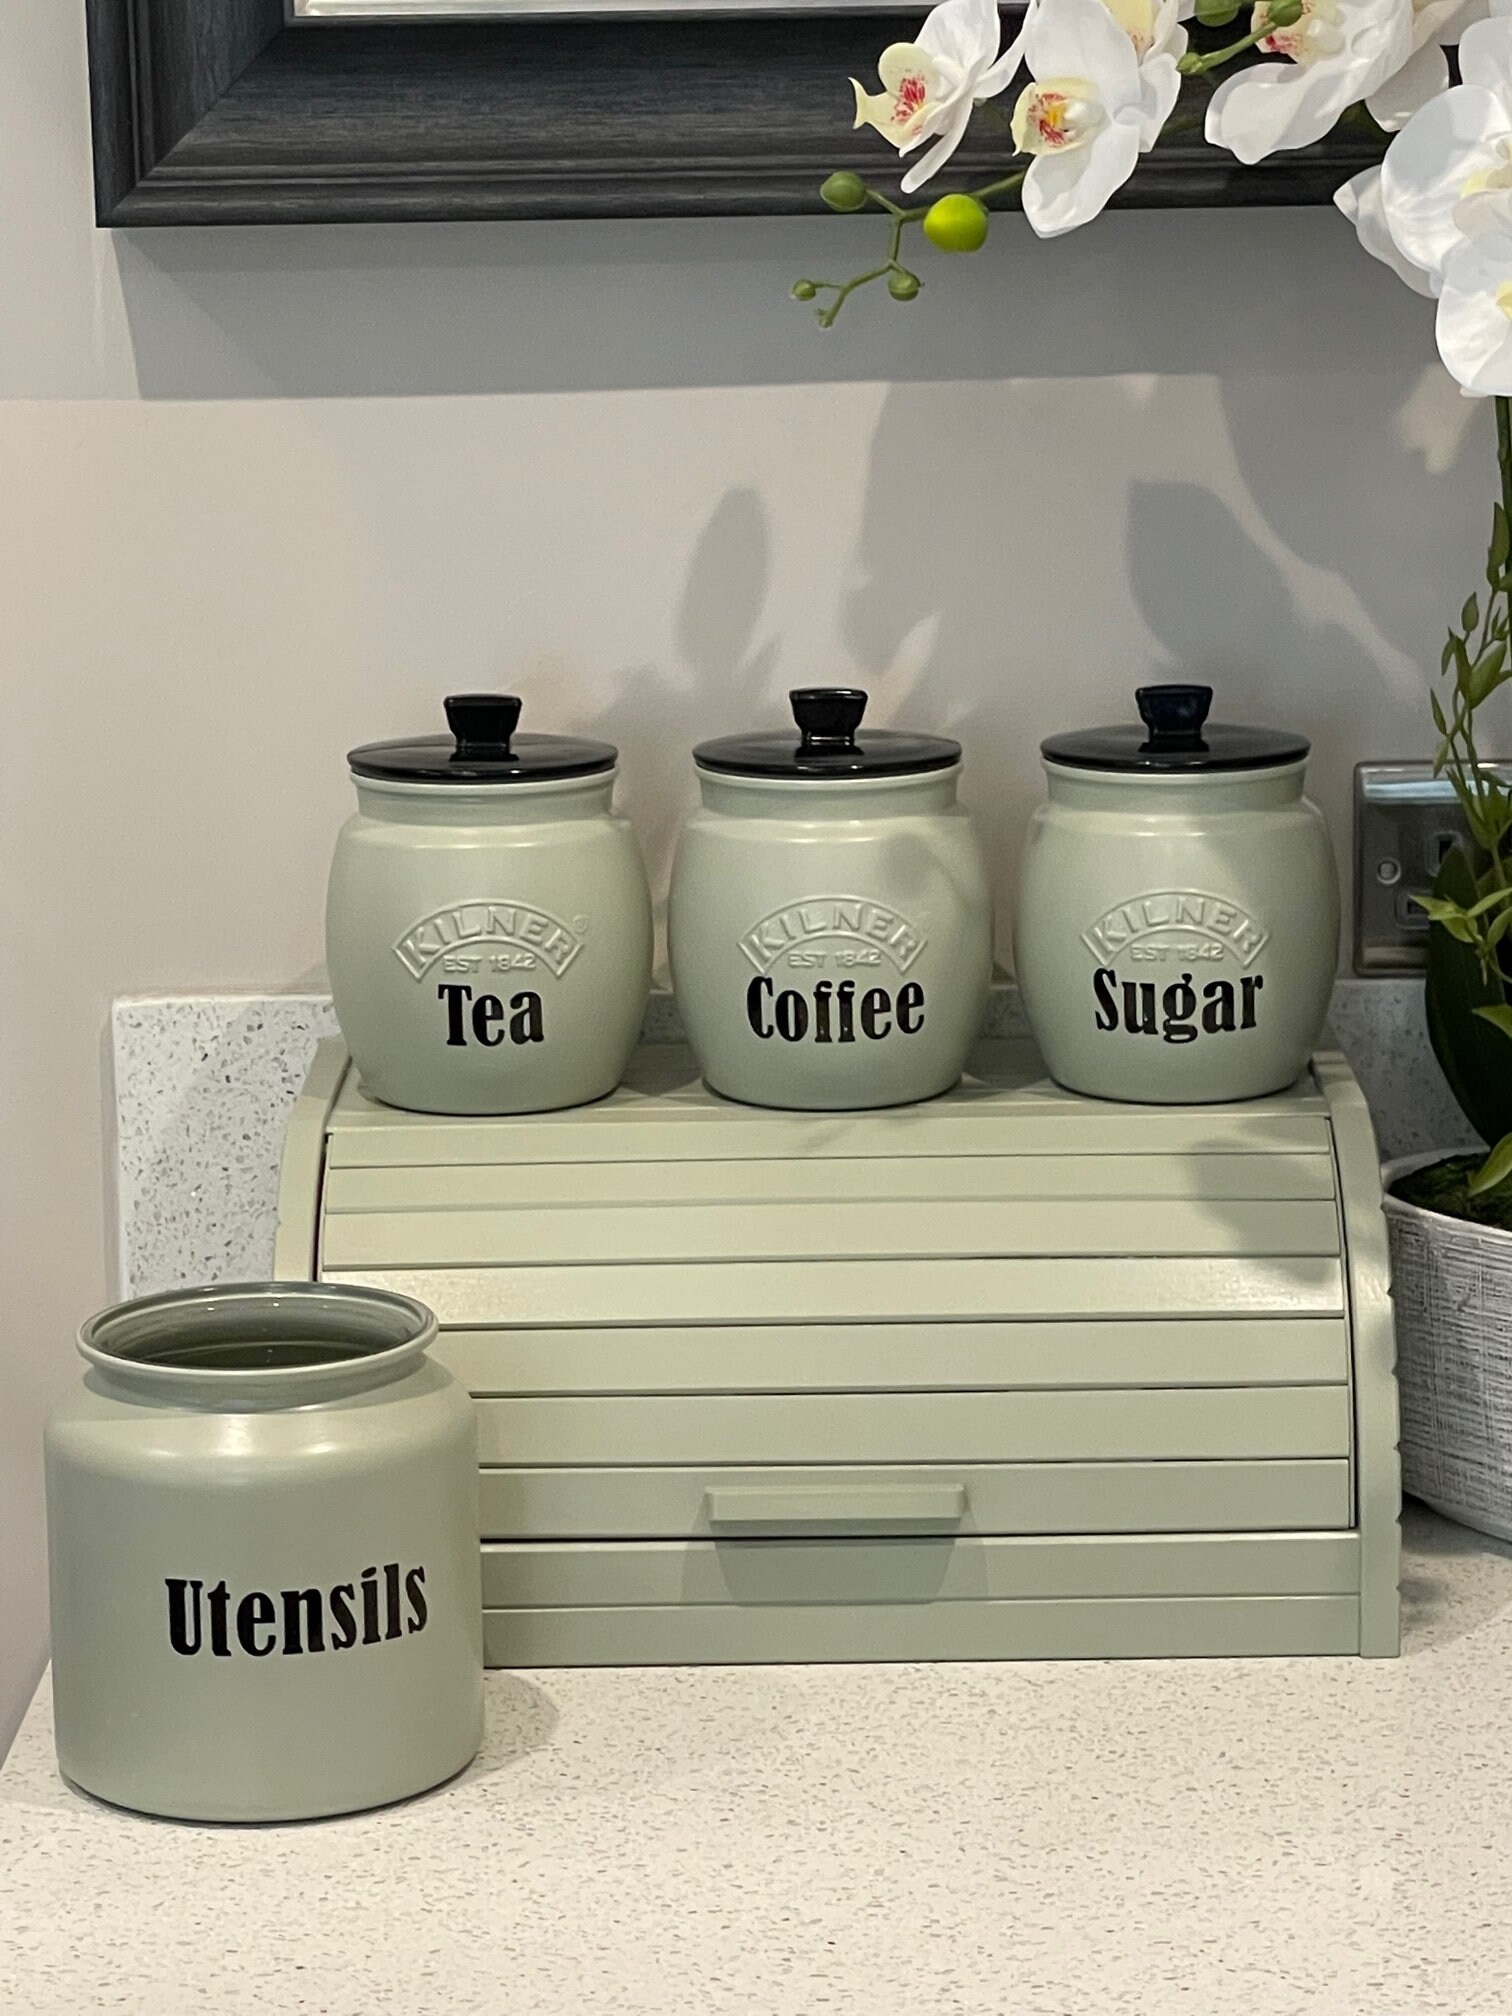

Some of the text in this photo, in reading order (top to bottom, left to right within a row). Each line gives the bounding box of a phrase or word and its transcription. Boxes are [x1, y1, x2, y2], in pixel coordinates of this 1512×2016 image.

[403, 905, 570, 969] KILNER
[750, 902, 918, 962] KILNER
[1093, 897, 1263, 954] KILNER
[1130, 942, 1225, 962] EST 1842
[443, 952, 537, 974] EST 1842
[787, 948, 882, 969] EST 1842
[437, 983, 545, 1047] Tea
[746, 975, 925, 1043] Coffee
[1093, 967, 1264, 1044] Sugar
[164, 1562, 428, 1657] Utensils
